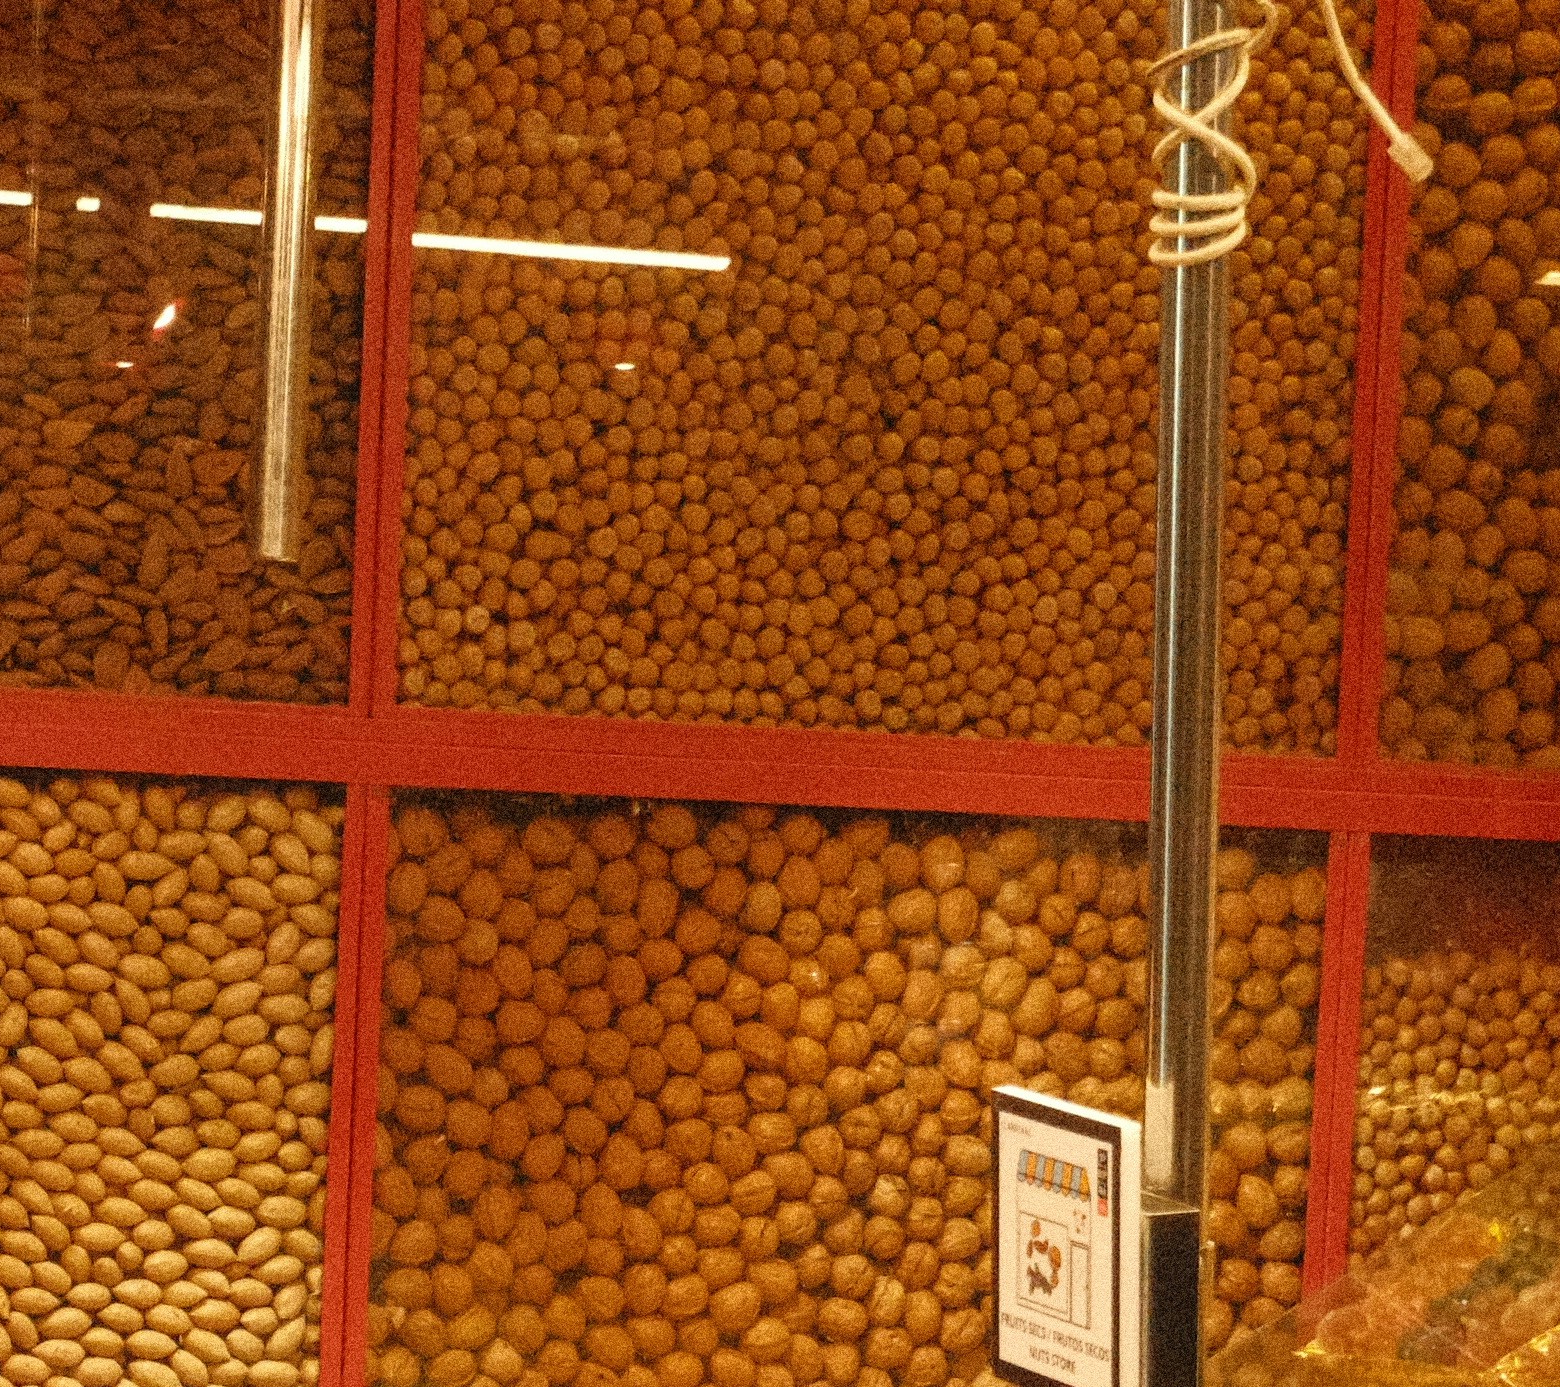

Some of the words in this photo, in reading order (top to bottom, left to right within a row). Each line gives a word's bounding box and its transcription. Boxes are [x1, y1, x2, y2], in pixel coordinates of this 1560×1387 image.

[1001, 1312, 1027, 1334] FRUITS
[1028, 1321, 1047, 1340] SECS
[1052, 1331, 1084, 1353] FRUTOS
[1084, 1342, 1111, 1362] SECOS
[1028, 1345, 1050, 1364] NUTS
[1050, 1354, 1077, 1374] STORE
